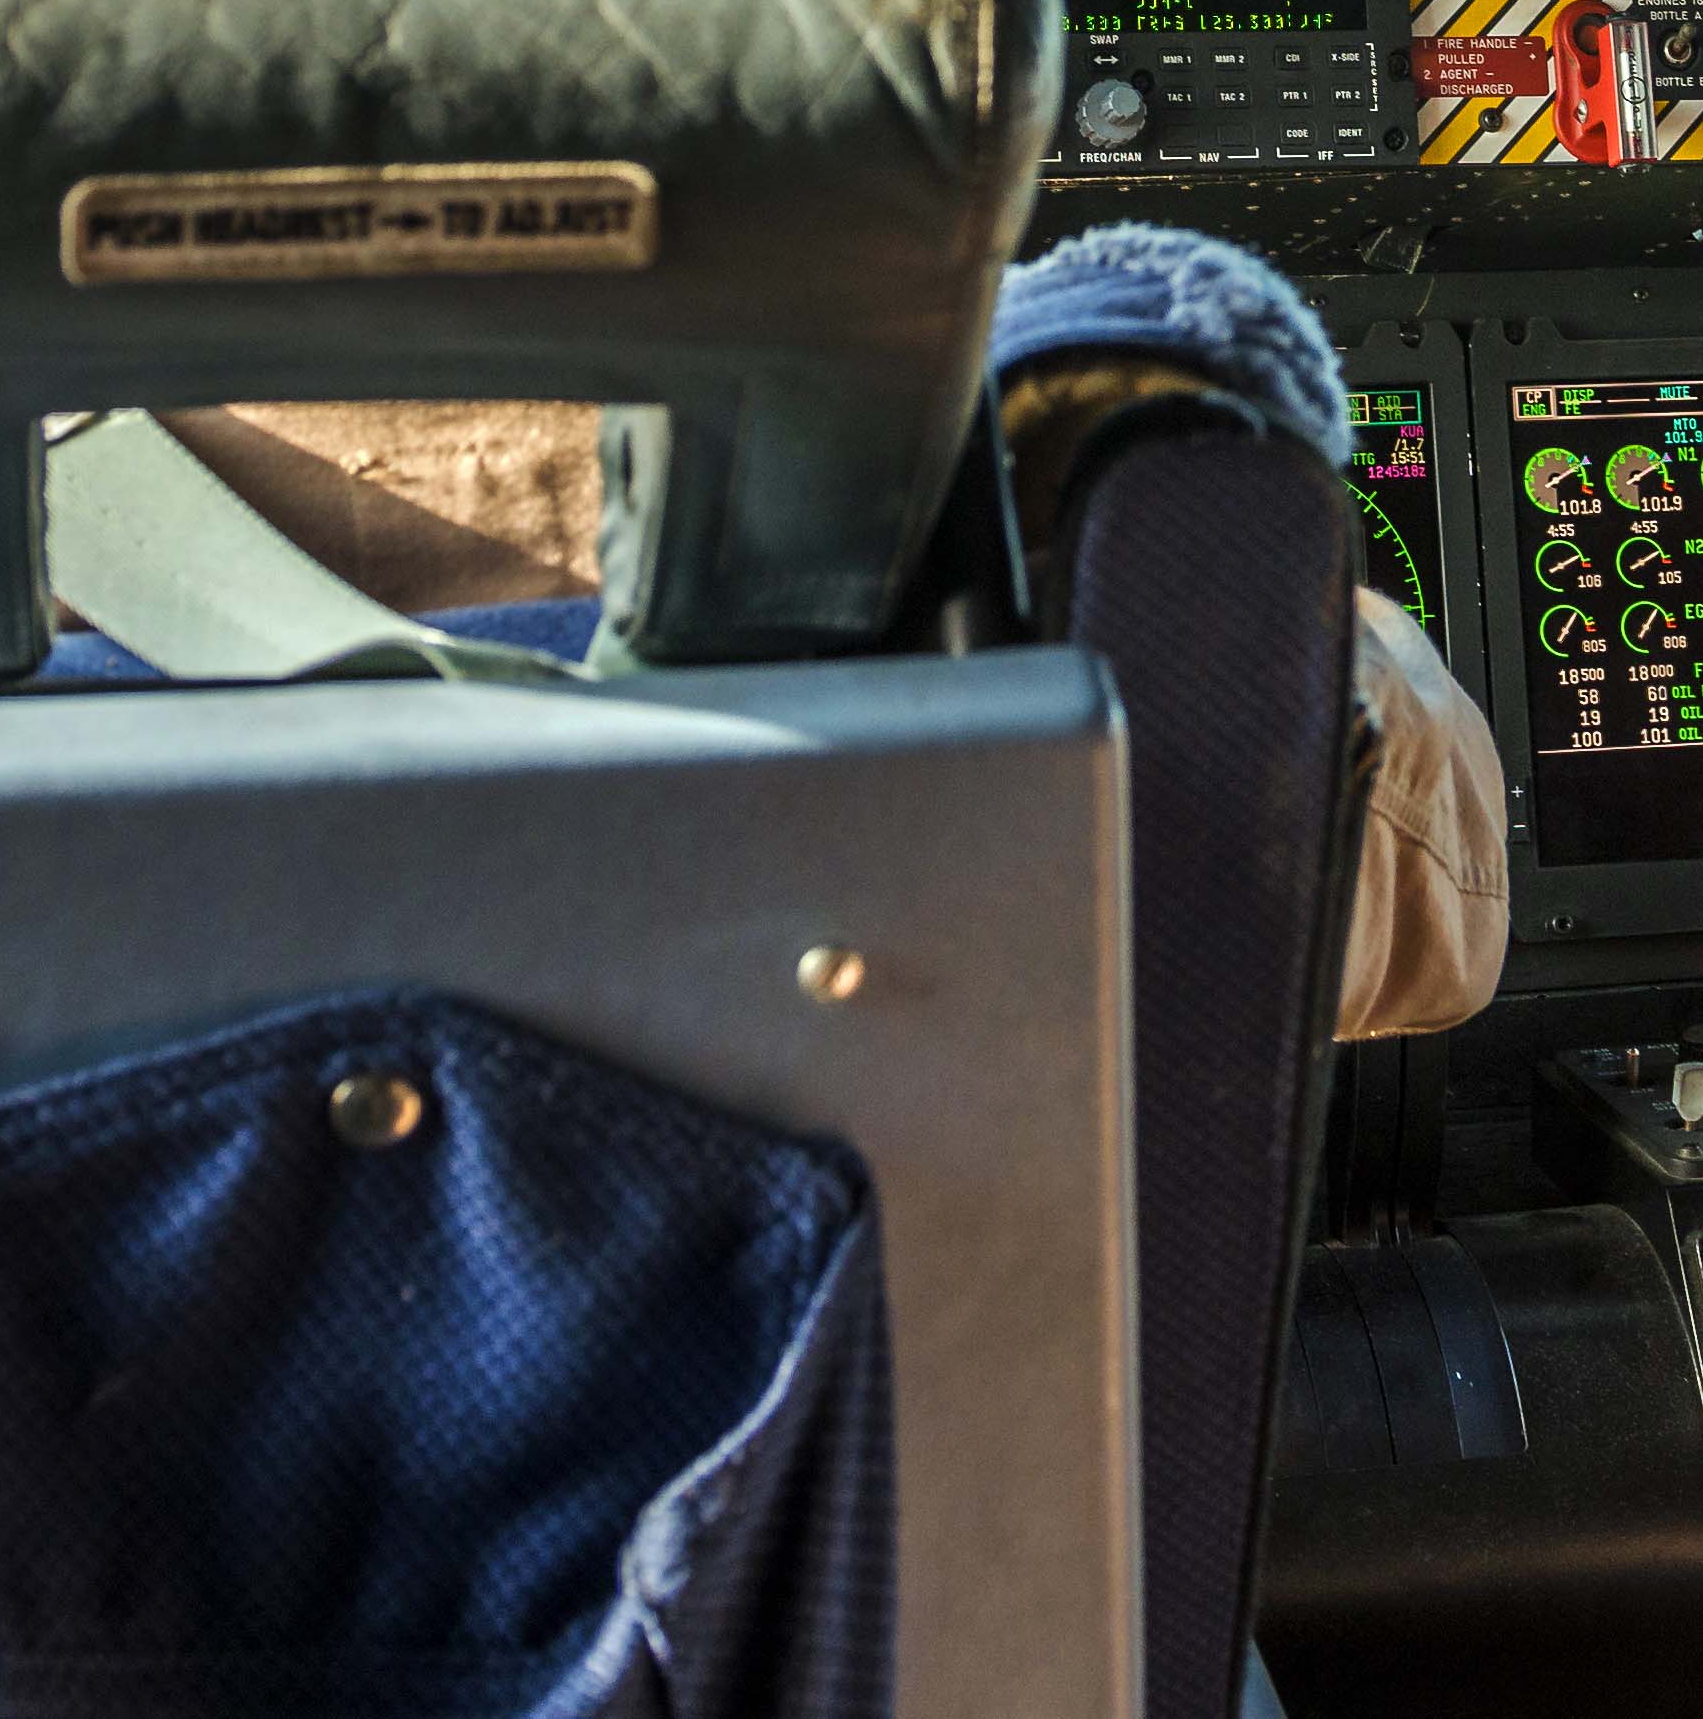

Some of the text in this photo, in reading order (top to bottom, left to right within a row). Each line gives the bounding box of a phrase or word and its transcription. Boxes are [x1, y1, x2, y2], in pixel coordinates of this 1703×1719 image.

[1090, 35, 1119, 45] SWAP
[1437, 38, 1517, 48] FIRE HANDLE
[1438, 54, 1484, 64] PULLED
[1440, 69, 1478, 80] AGENT
[1440, 84, 1513, 95] DISCHARGED
[1287, 129, 1308, 138] CODE
[1080, 152, 1142, 163] FREQ/CHAN
[1199, 153, 1219, 163] NAV
[1526, 391, 1542, 403] CP
[1660, 386, 1690, 399] MUTE
[1523, 404, 1547, 416] ENG
[1674, 418, 1697, 430] MTO
[1391, 452, 1425, 464] 15:51
[1678, 448, 1697, 461] N1
[1559, 499, 1601, 515] 101.8
[1547, 524, 1575, 536] 4:55
[1559, 668, 1604, 684] 18500
[1629, 665, 1673, 681] 18000
[1578, 689, 1598, 705] 58
[1648, 685, 1667, 700] 60
[1672, 686, 1695, 698] OIL
[1641, 729, 1670, 744] 101
[1679, 727, 1703, 740] OIL
